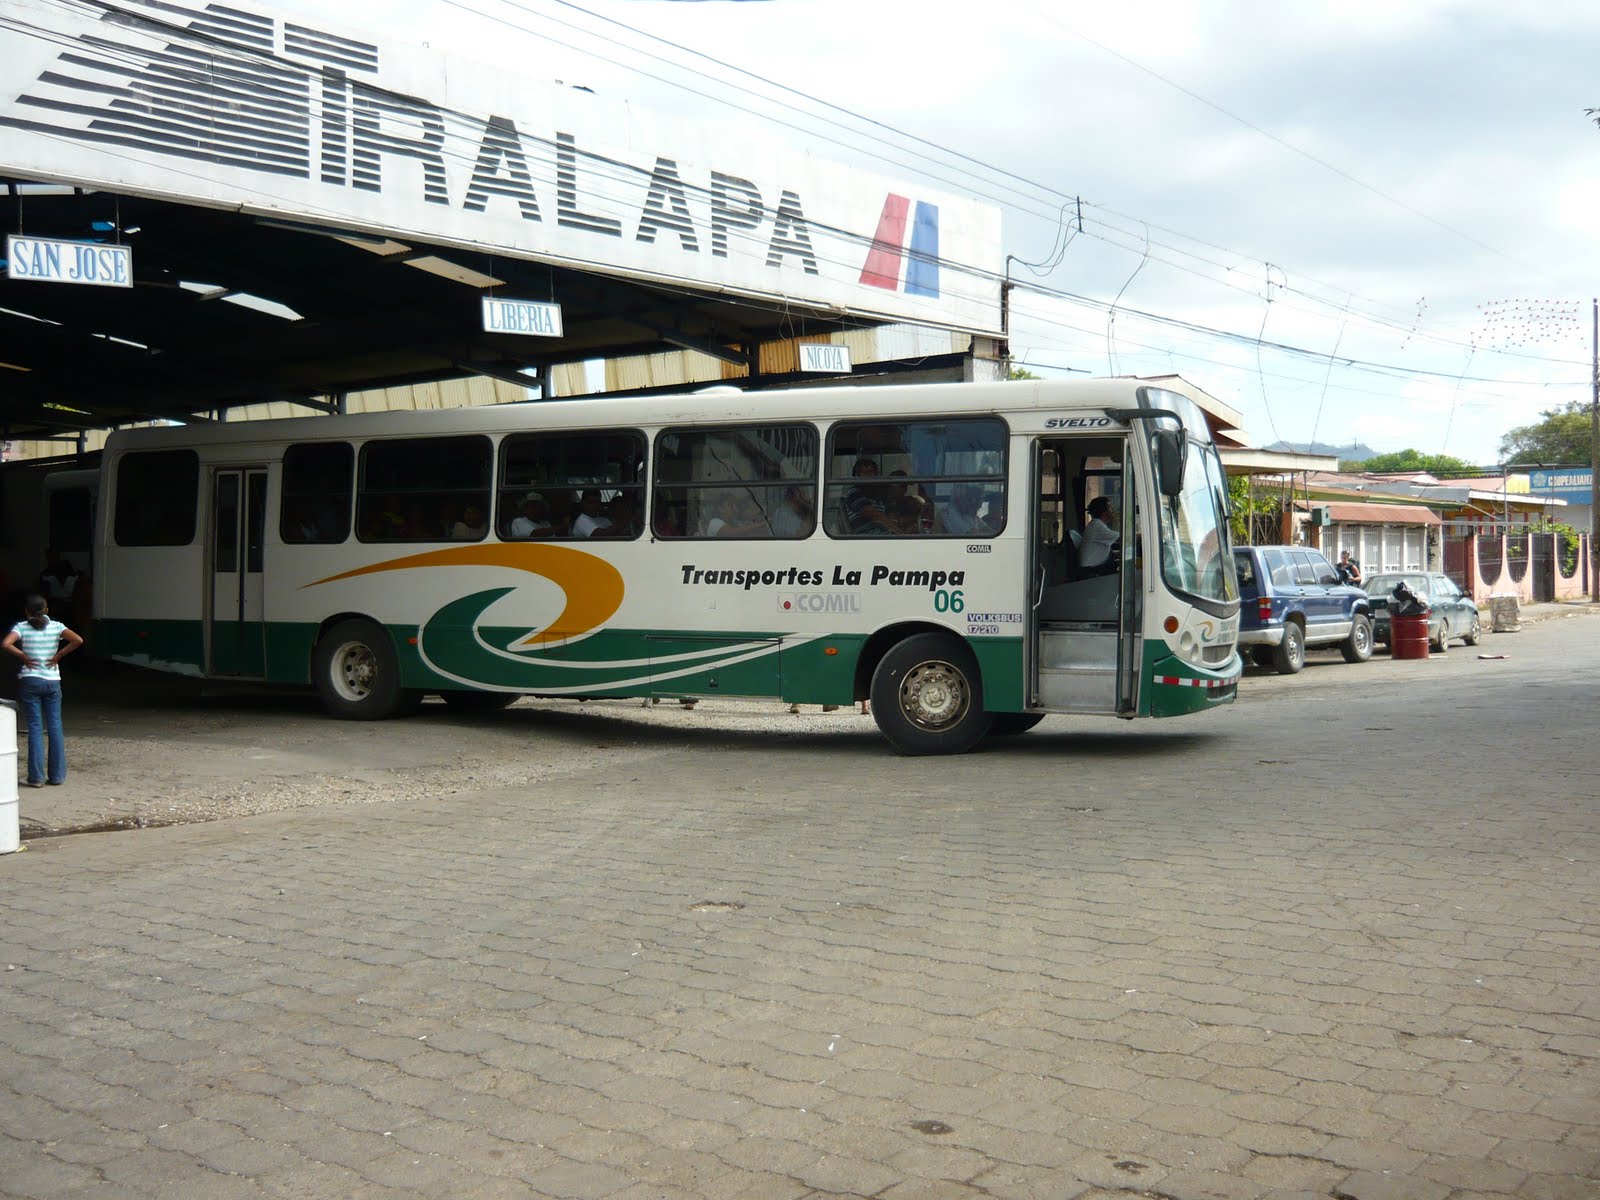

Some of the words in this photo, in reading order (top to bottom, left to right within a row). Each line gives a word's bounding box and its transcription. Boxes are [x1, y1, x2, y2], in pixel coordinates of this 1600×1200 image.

[285, 22, 819, 276] TRALAPA
[13, 240, 61, 278] SAN
[69, 246, 126, 283] JOSE
[488, 301, 555, 334] LIBERIA
[806, 346, 844, 370] NICOYA
[1045, 418, 1111, 428] SVELTO
[1548, 474, 1592, 487] COOPEALIANZ
[967, 545, 991, 553] COMIL
[681, 565, 823, 590] Transportes
[831, 565, 862, 586] La
[870, 565, 965, 591] Pampa
[797, 595, 859, 612] COMIL
[934, 589, 965, 613] 06
[968, 614, 1022, 622] VOLKSBUS
